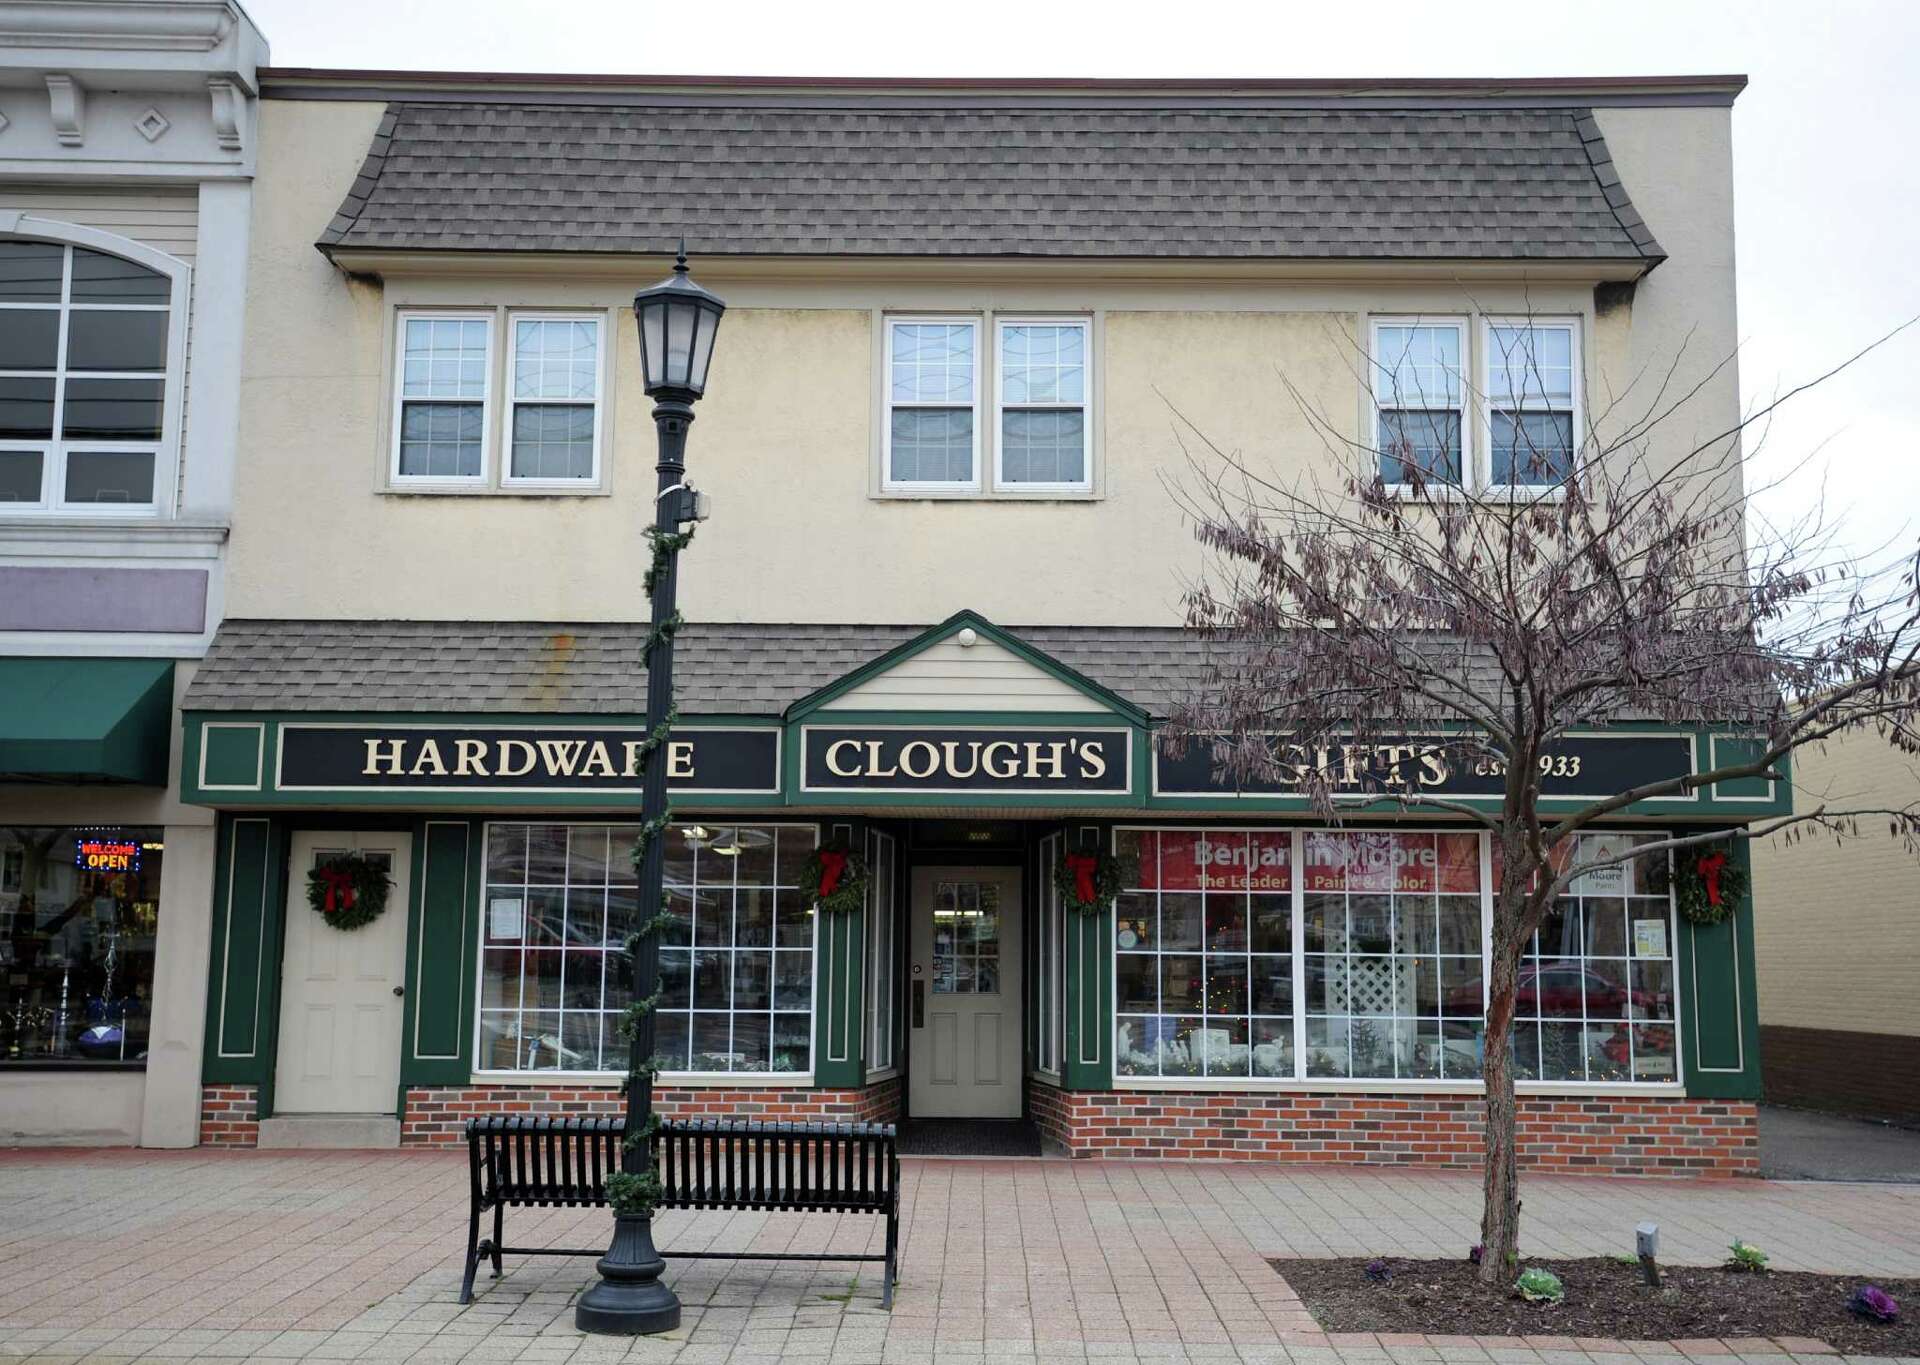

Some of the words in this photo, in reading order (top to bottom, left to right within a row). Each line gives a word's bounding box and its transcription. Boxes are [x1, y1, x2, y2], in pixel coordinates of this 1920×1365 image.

[825, 738, 1106, 778] CLOUGH'S
[1537, 755, 1581, 777] 933
[82, 843, 135, 855] WELCOME
[88, 854, 128, 868] OPEN
[1195, 874, 1226, 888] The
[1231, 875, 1289, 889] Leader
